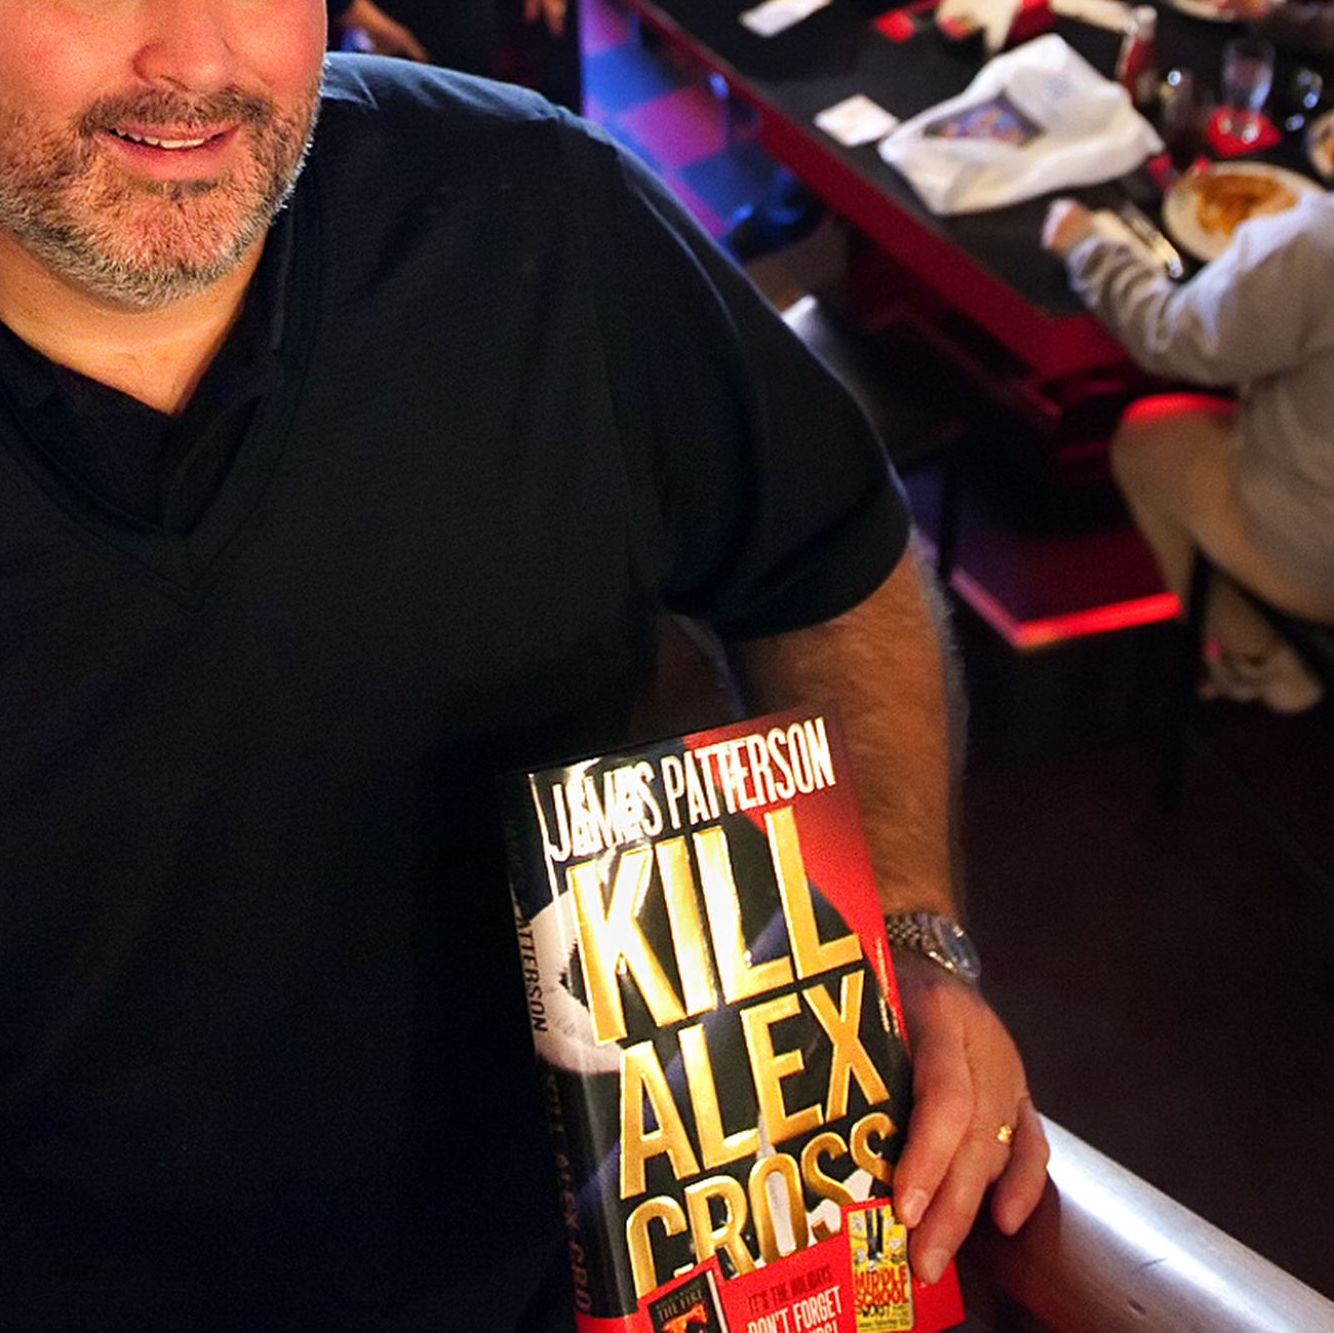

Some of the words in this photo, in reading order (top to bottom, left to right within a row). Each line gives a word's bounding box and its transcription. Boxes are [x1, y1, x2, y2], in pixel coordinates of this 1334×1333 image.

[549, 761, 664, 862] JAMES
[660, 716, 836, 831] PATTERSON
[567, 806, 863, 1045] KILL
[620, 968, 891, 1200] ALEX
[555, 1153, 581, 1230] ALEX
[568, 1240, 593, 1315] CRO
[625, 1112, 897, 1299] CROSS
[854, 1264, 908, 1288] MIDDLE
[792, 1285, 842, 1332] FORGET
[854, 1284, 909, 1309] SCHOOL
